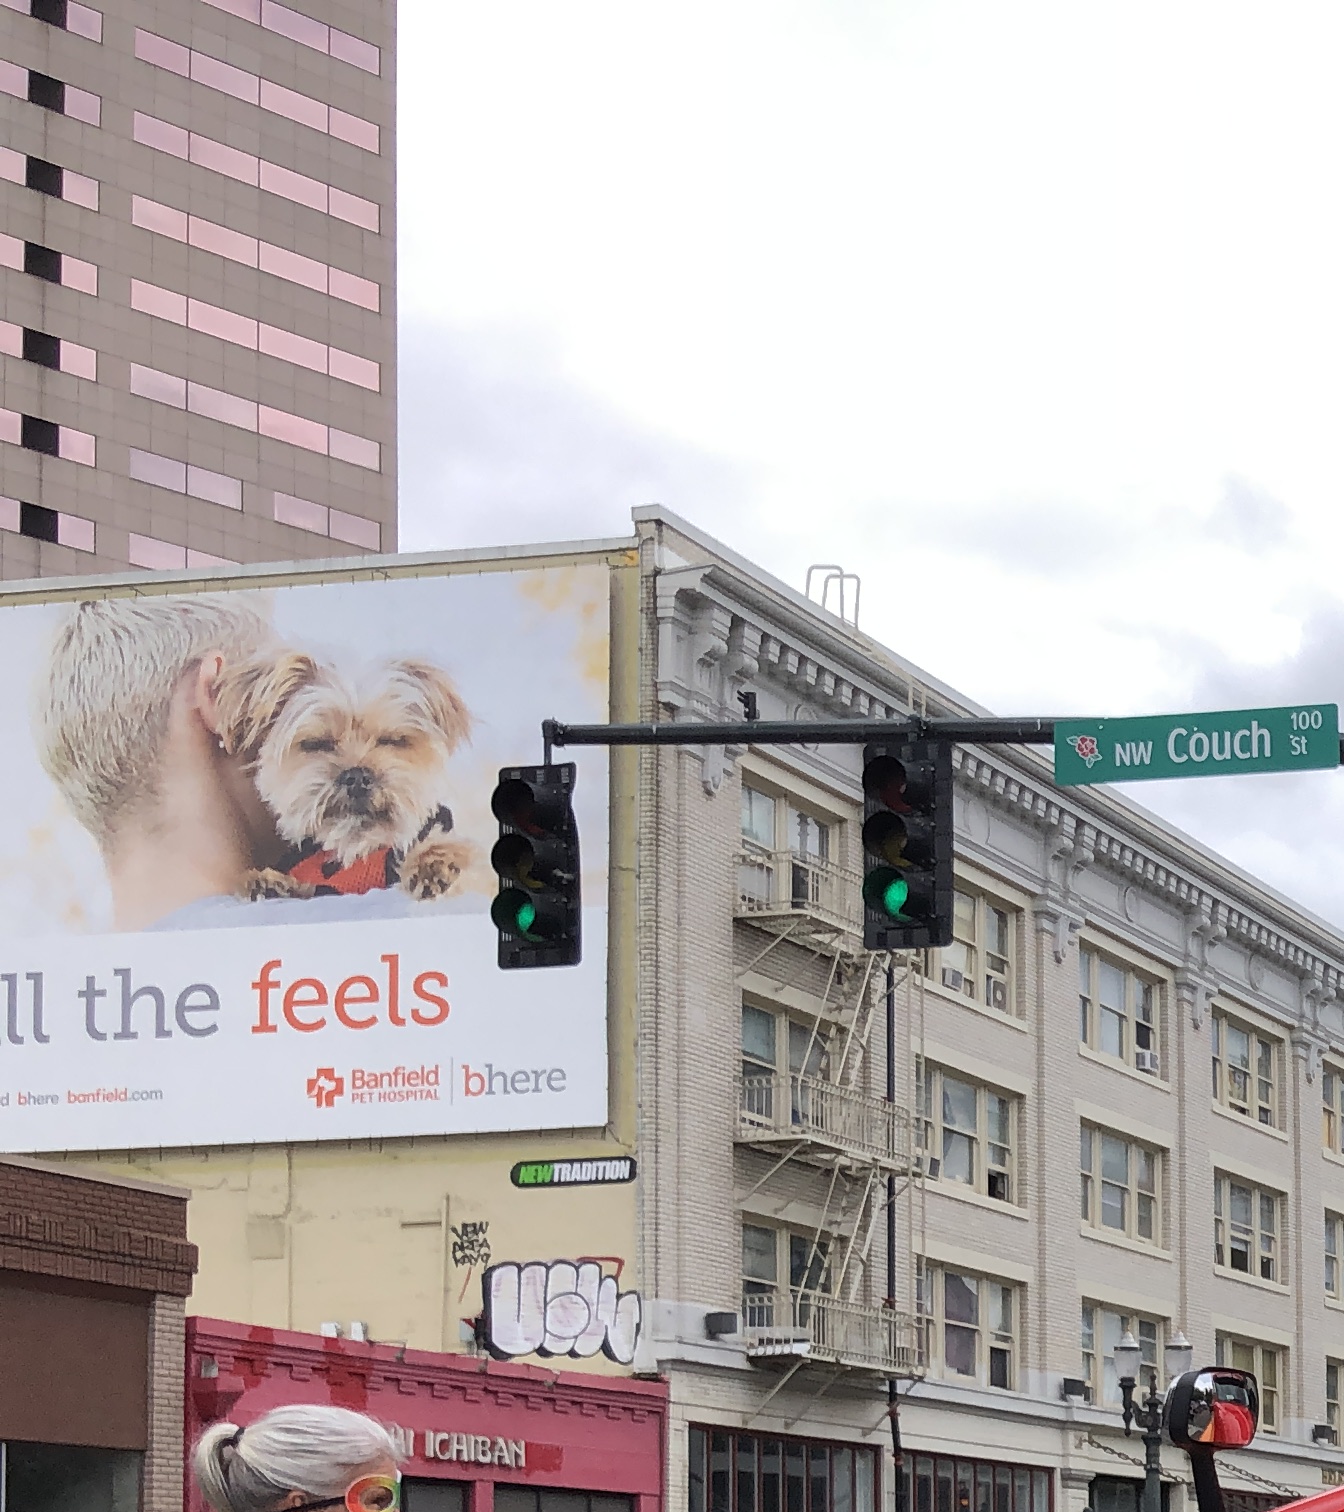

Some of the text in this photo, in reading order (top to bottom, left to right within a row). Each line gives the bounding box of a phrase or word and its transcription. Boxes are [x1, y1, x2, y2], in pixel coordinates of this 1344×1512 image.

[1290, 710, 1322, 731] 100
[1114, 720, 1308, 767] NW Couch St
[0, 953, 451, 1046] ll the feels
[351, 1063, 567, 1097] Banfield bhere
[351, 1088, 440, 1104] PET HOSPITAL
[425, 1429, 526, 1468] ICHIBAN
